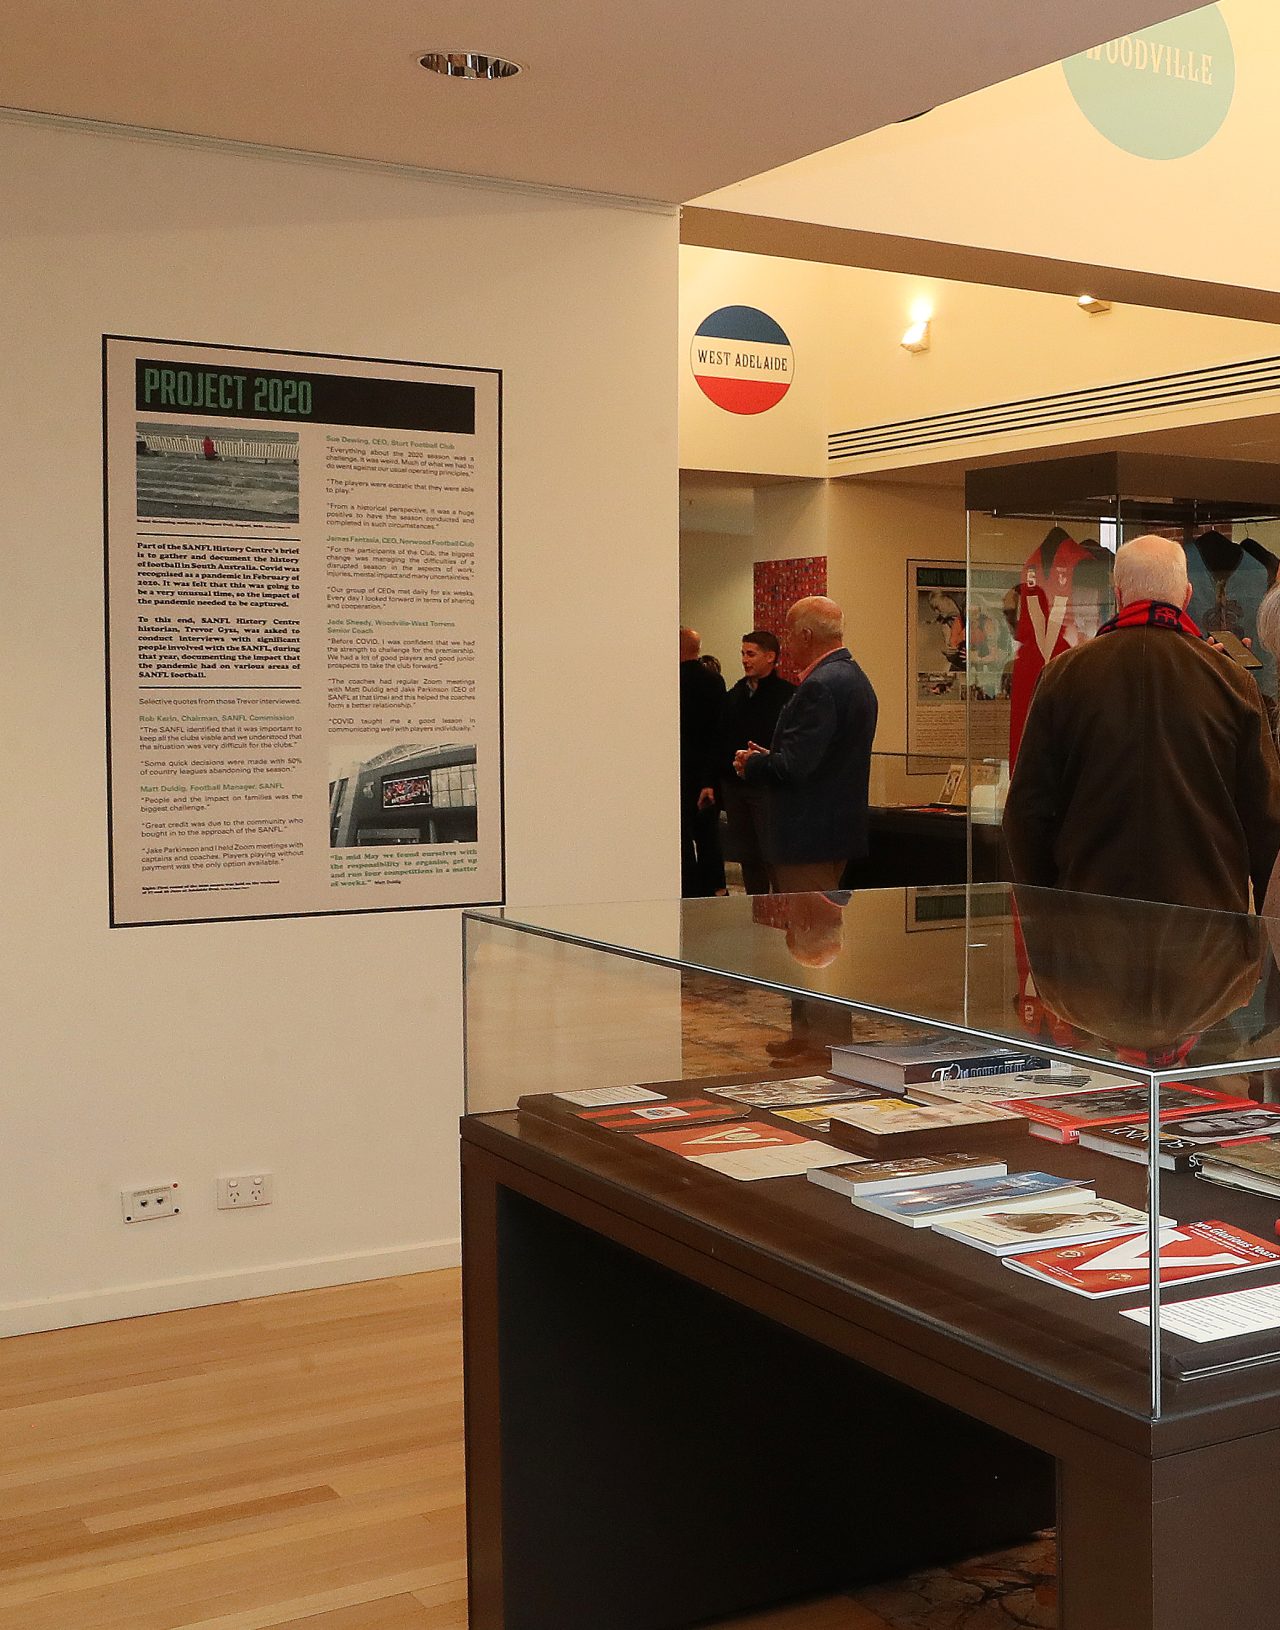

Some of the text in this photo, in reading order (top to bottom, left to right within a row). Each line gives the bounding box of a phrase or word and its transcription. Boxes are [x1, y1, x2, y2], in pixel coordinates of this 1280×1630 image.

[697, 349, 788, 372] WEST ADELAIDE
[144, 368, 313, 415] PROJECT 2020
[137, 541, 155, 549] Part
[182, 543, 211, 551] SANFL
[213, 544, 243, 554] History
[159, 551, 187, 561] gather
[209, 553, 250, 561] document
[270, 555, 298, 565] history
[147, 560, 180, 568] football
[137, 569, 183, 579] recognised
[201, 571, 241, 581] pandemic
[253, 573, 289, 582] February
[266, 582, 288, 591] going
[262, 591, 289, 600] impact
[154, 597, 194, 606] pandemic
[236, 617, 266, 626] History
[179, 634, 224, 642] interviews
[257, 636, 300, 644] significant
[138, 643, 166, 652] people
[273, 645, 300, 653] during
[181, 653, 236, 661] documenting
[253, 653, 281, 662] impact
[156, 662, 197, 670] pandemic
[173, 698, 197, 706] quotes
